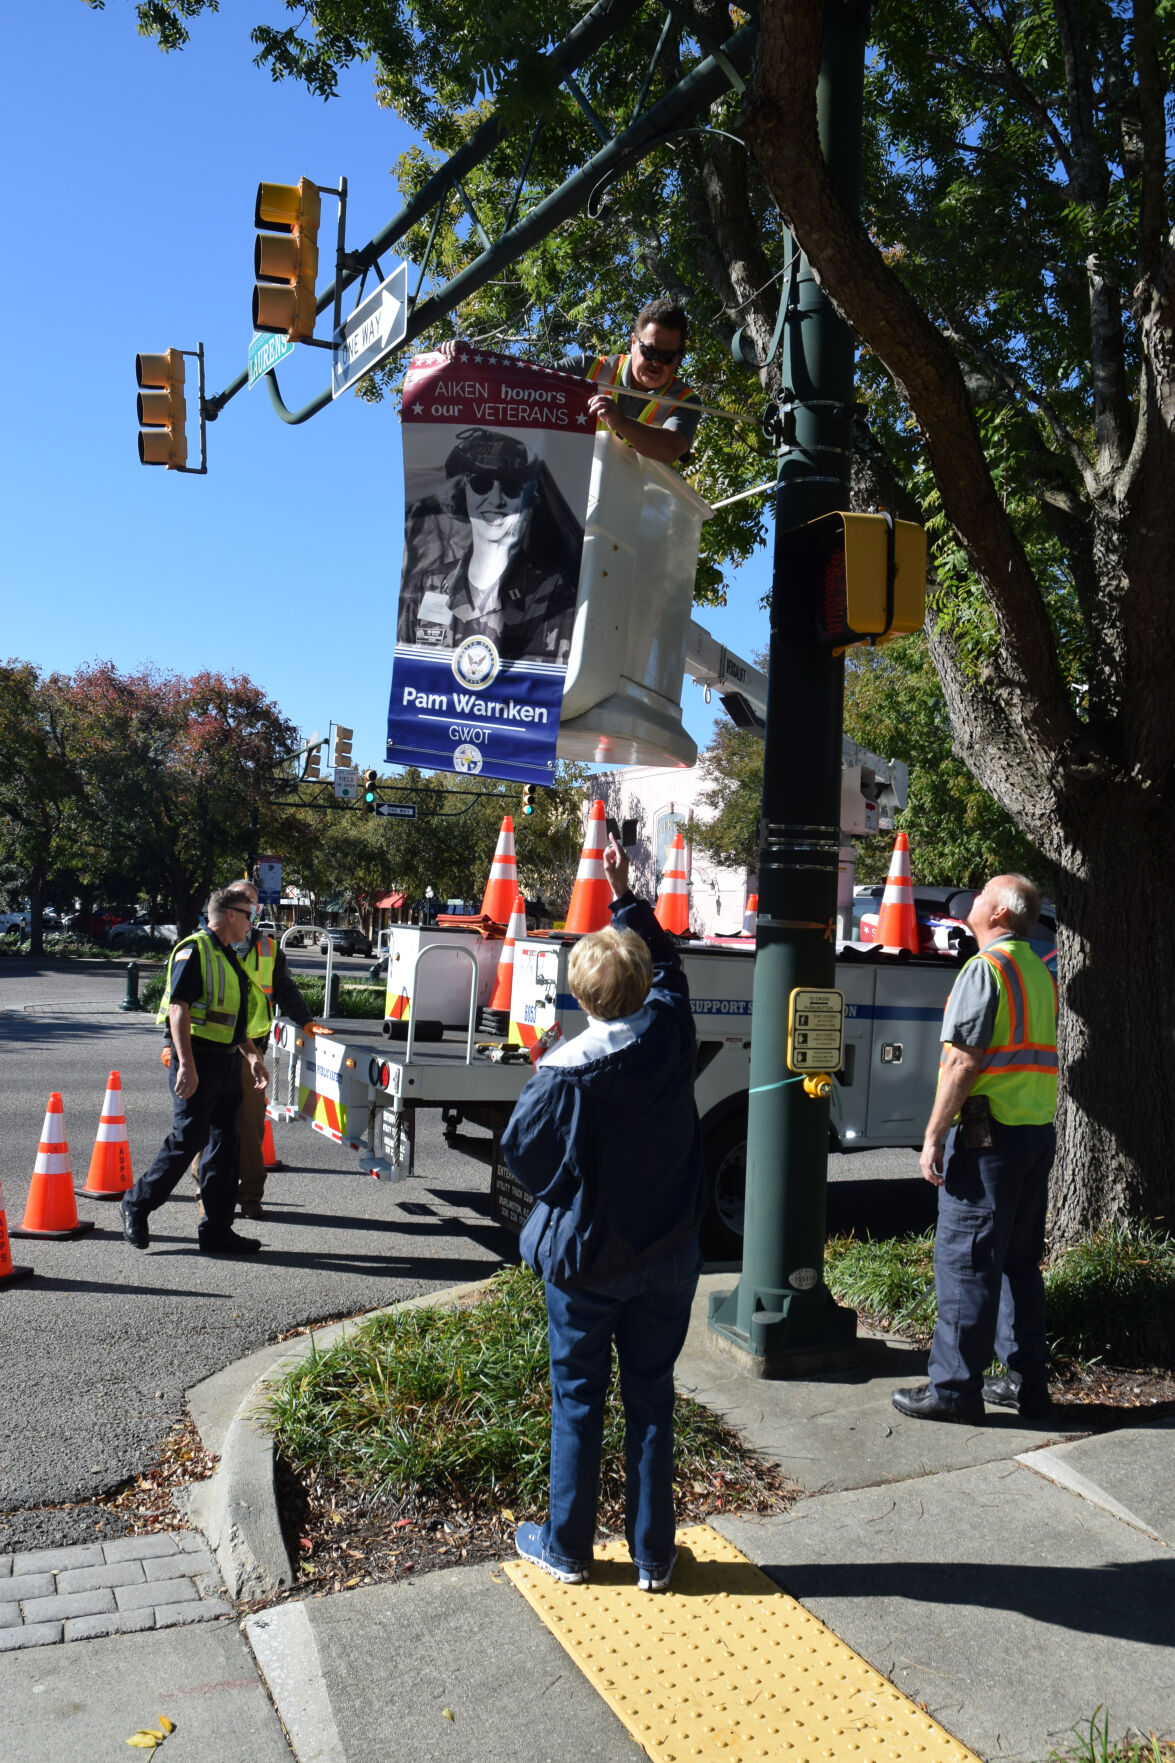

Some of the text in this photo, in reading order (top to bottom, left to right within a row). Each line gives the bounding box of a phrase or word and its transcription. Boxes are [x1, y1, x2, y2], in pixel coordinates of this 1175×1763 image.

[342, 312, 382, 365] ONE WAY
[250, 333, 288, 382] LAURENS
[434, 380, 566, 404] AIKEN honors
[431, 402, 569, 425] our VETERANS
[403, 687, 548, 724] Pam Warnken
[449, 725, 492, 744] GWOT
[690, 1000, 746, 1013] SUPPORT
